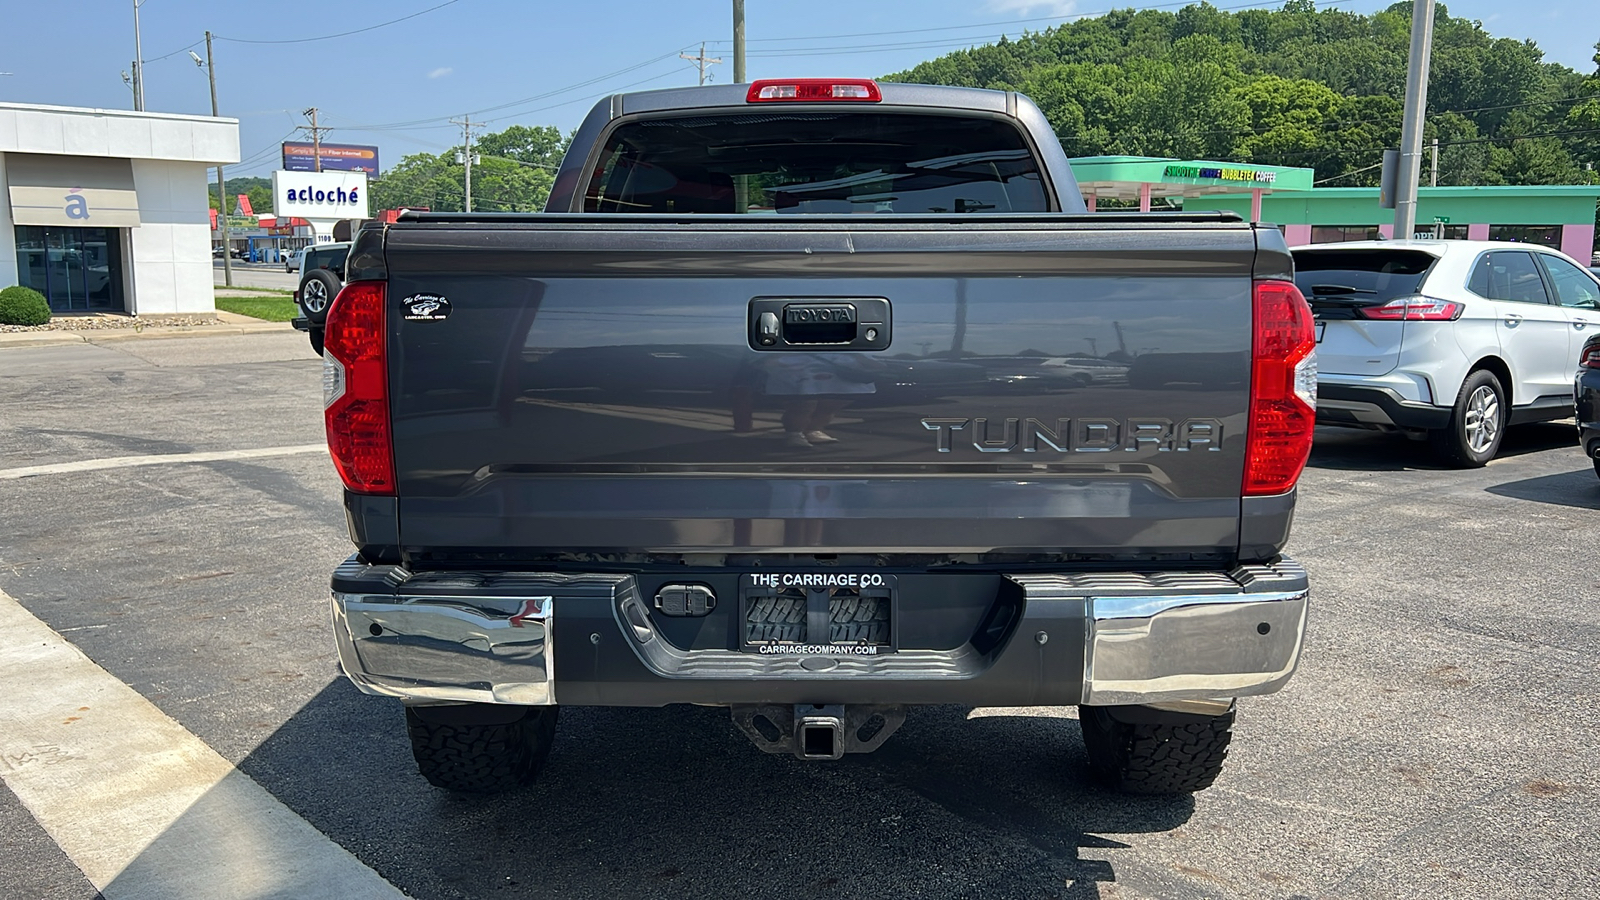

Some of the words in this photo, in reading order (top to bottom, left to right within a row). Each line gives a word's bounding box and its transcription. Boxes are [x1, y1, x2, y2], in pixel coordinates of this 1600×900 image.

[1221, 169, 1255, 182] BUBBLETEA
[1255, 171, 1277, 182] COFFEE
[287, 185, 359, 203] acloché
[789, 308, 852, 321] TOYOTA
[920, 417, 1225, 453] TUNDRA
[750, 573, 780, 587] THE
[782, 573, 857, 586] CARRIAGE
[860, 573, 886, 587] CO.
[759, 645, 877, 655] CARRIAGECOMPANY.COM
